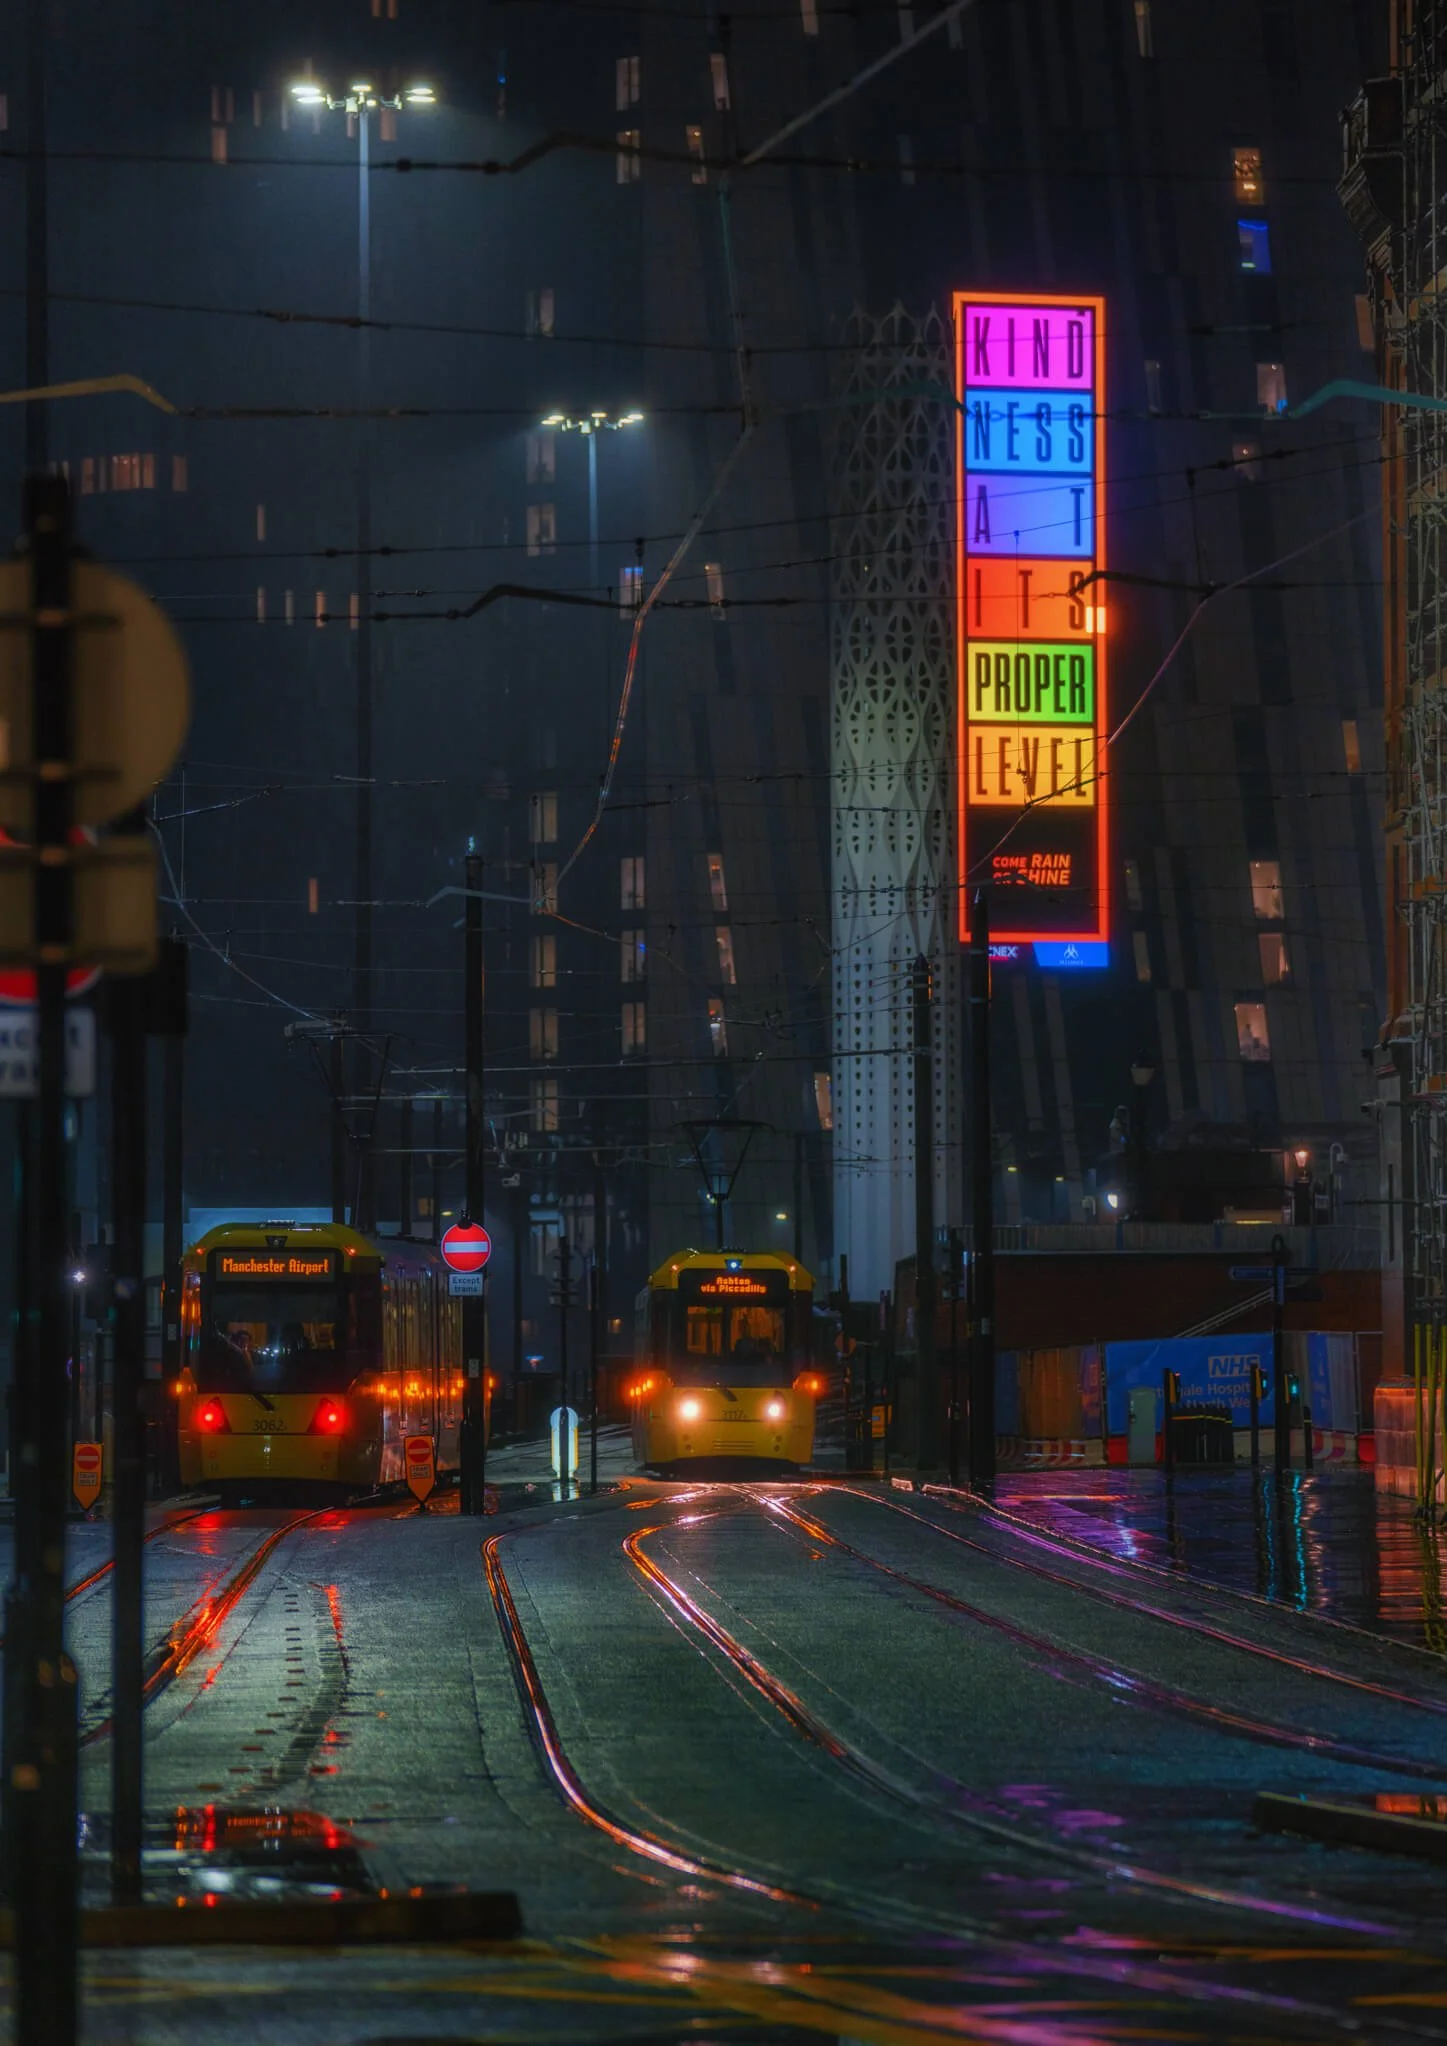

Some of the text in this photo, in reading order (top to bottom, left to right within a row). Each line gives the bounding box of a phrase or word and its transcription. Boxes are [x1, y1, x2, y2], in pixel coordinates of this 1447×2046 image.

[974, 316, 1083, 379] KIND
[974, 401, 1084, 463] NESS
[974, 485, 1085, 546] AT
[975, 569, 1084, 630] ITS
[975, 652, 1086, 714] PROPER
[975, 736, 1087, 798] LEVEL
[992, 853, 1071, 869] COME RAIN
[223, 1257, 329, 1277] Manchester Airport
[716, 1276, 752, 1285] Ashton
[700, 1284, 767, 1294] via Piccadilly
[1211, 1356, 1259, 1376] NHS
[1207, 1382, 1251, 1396] Hospit
